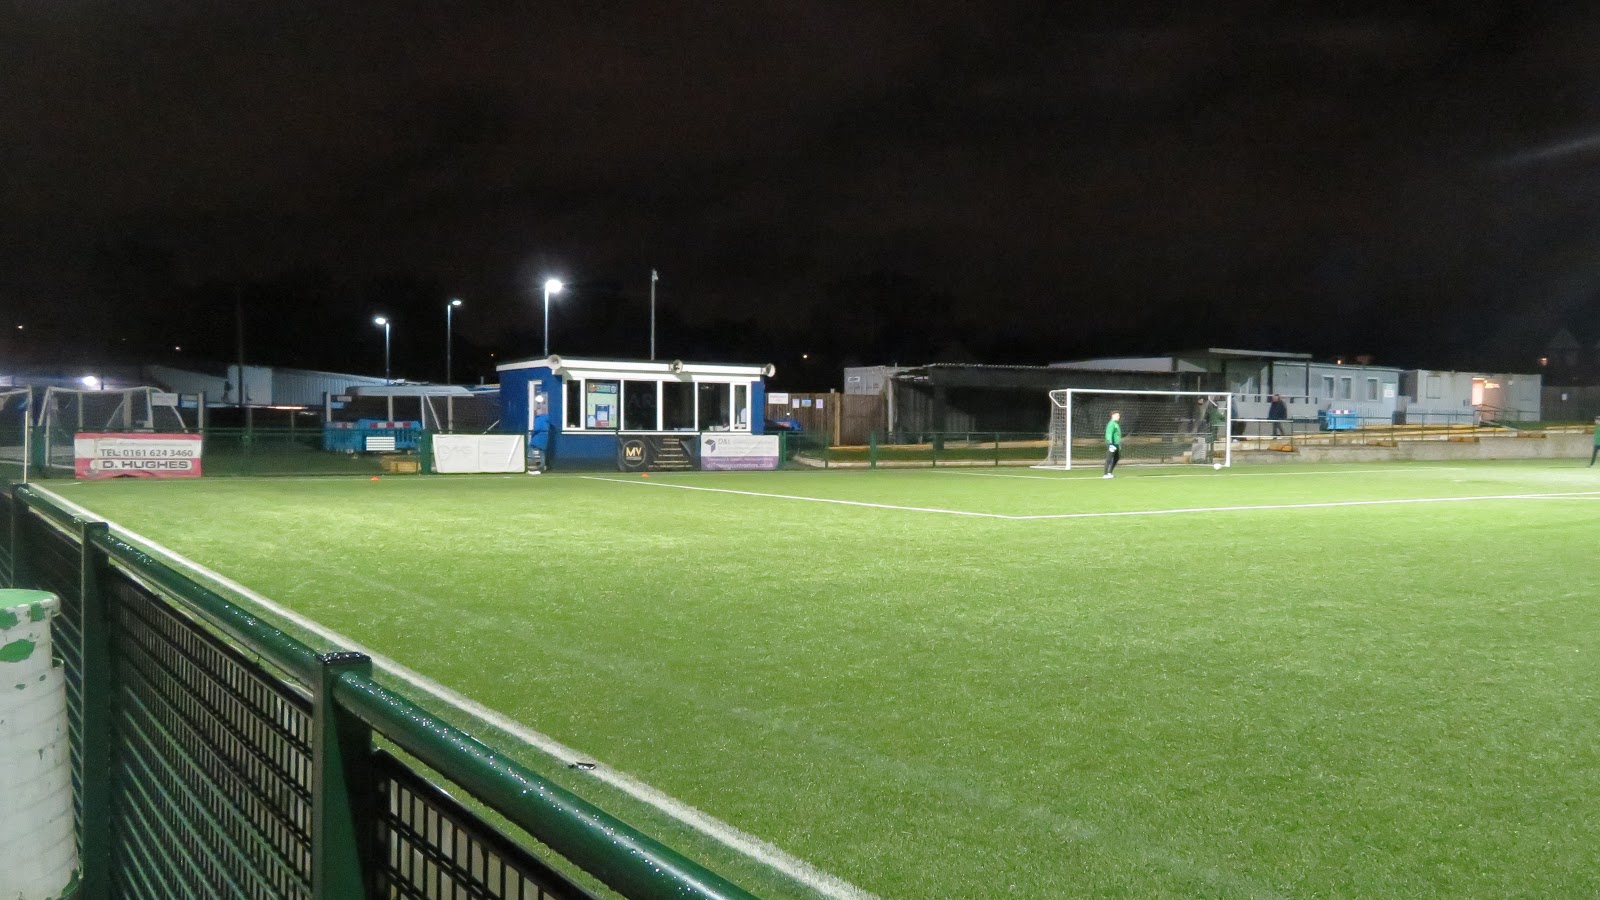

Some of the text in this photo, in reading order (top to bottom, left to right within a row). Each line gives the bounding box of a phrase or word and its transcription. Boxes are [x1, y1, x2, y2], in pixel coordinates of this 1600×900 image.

[100, 448, 193, 457] TEL: 0161 624 3460
[625, 447, 642, 457] MV
[102, 460, 188, 469] D. HUGHES
